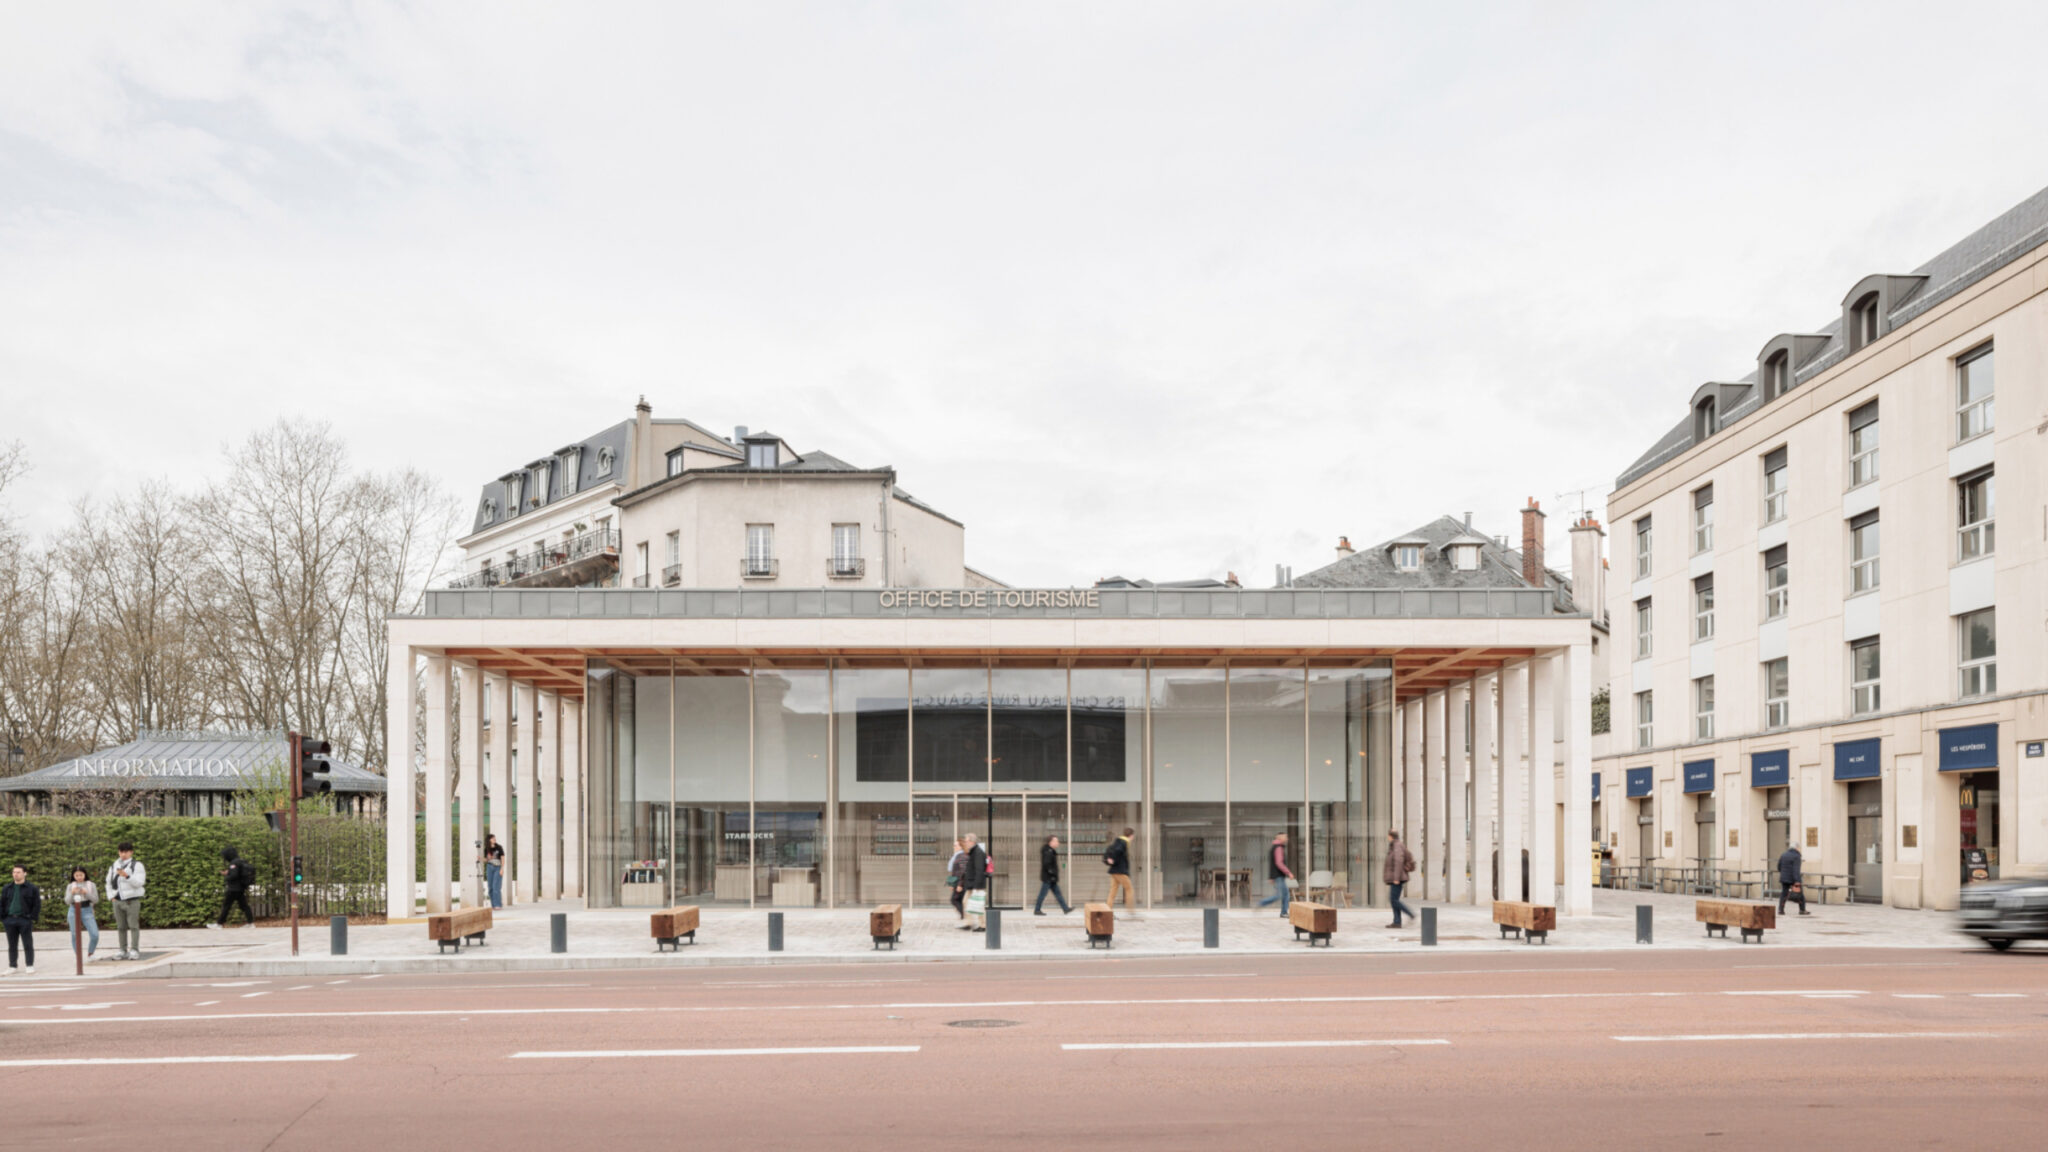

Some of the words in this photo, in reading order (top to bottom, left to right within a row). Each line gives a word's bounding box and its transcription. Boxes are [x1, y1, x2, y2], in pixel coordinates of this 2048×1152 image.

[879, 590, 953, 608] OFFICE
[959, 590, 987, 608] DE
[992, 590, 1099, 608] TOURISME
[74, 758, 242, 777] INFORMATION
